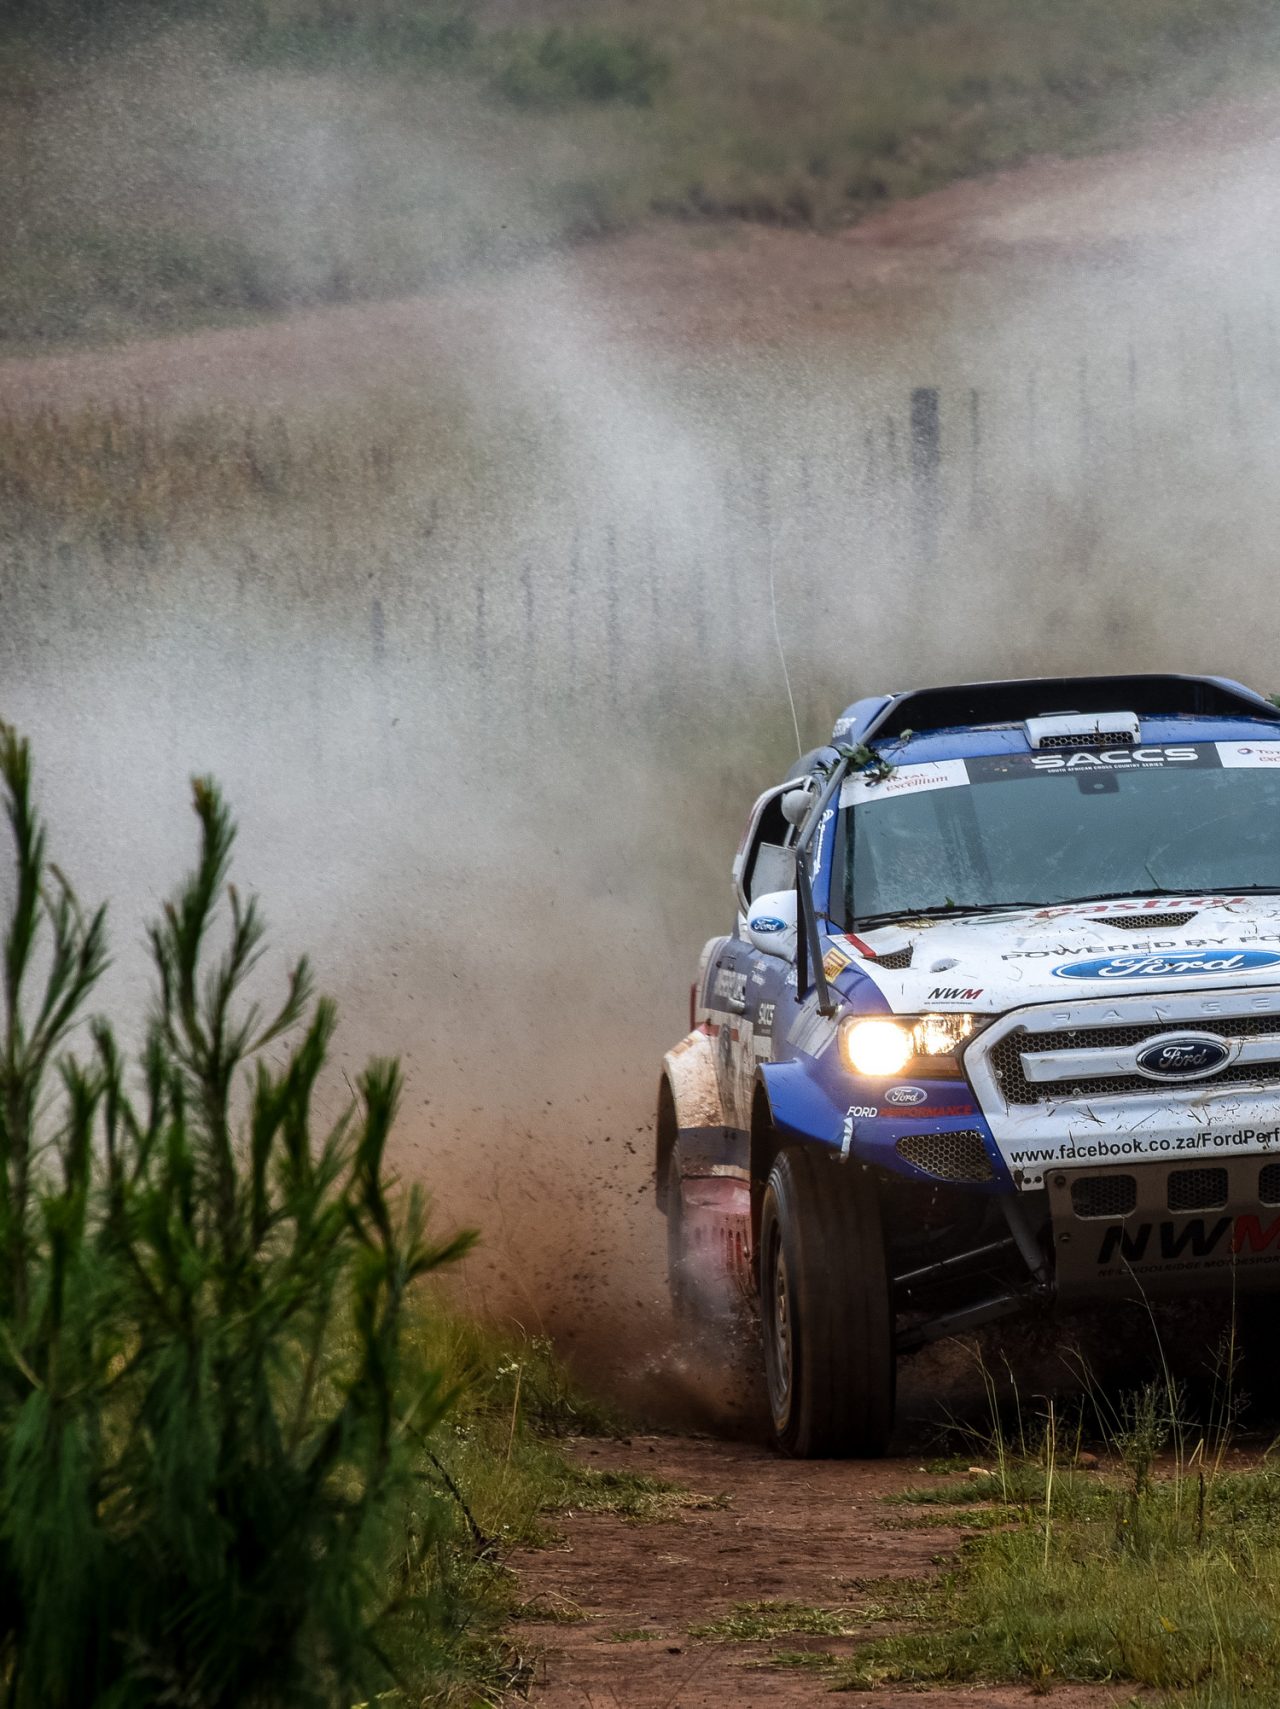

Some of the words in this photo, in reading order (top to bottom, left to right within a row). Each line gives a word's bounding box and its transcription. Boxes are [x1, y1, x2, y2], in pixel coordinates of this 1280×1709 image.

[1031, 748, 1199, 769] SACCS
[1067, 765, 1093, 773] AFRICAN
[886, 776, 949, 791] excellium
[753, 917, 780, 931] Ford
[1001, 941, 1176, 961] POWERED
[1185, 938, 1228, 947] BY
[1098, 953, 1245, 977] Ford
[928, 988, 984, 999] NWM
[1159, 1045, 1208, 1068] Ford
[891, 1088, 919, 1102] Ford
[847, 1105, 878, 1118] FORD
[879, 1104, 974, 1118] PERFORMANCE
